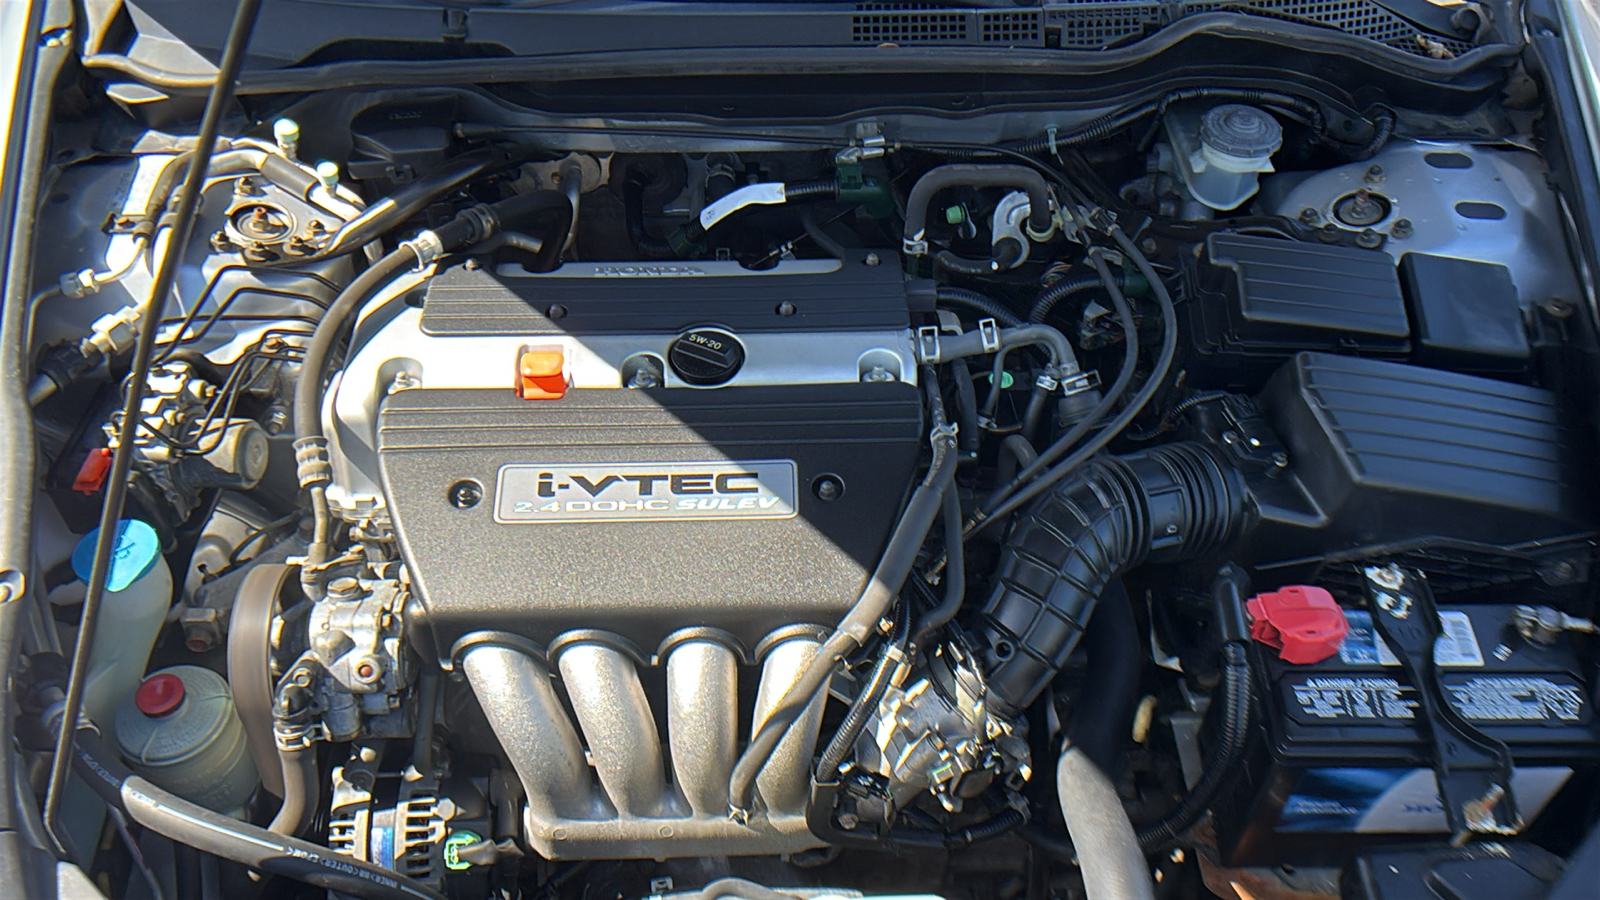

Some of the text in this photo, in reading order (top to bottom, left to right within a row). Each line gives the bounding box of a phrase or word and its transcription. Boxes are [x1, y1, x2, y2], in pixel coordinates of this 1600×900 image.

[688, 333, 723, 350] 5W-20
[537, 471, 758, 497] i-VTEC
[513, 495, 779, 513] 2.4 DOHC SULEV
